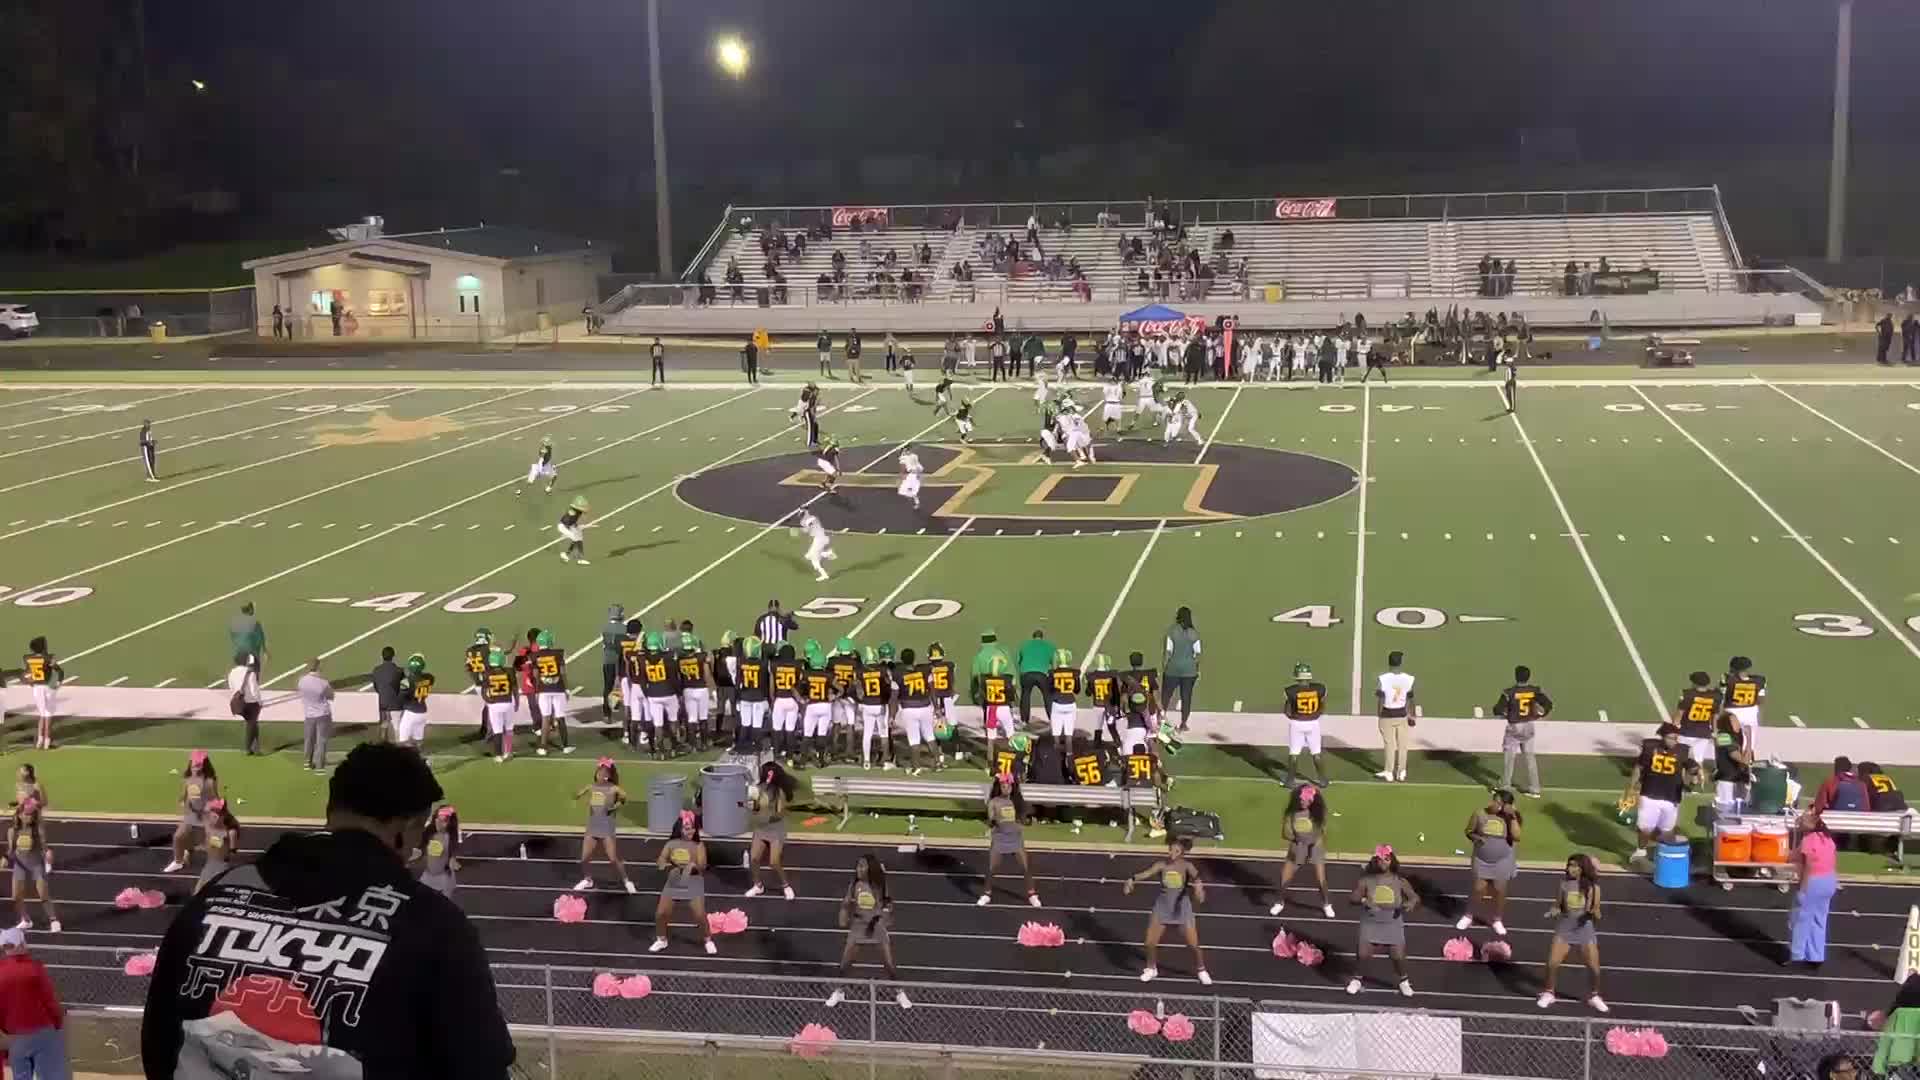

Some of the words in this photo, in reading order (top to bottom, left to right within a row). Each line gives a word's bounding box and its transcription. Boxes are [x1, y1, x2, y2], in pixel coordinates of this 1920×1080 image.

[743, 671, 758, 689] 14
[776, 673, 796, 690] 20
[866, 678, 881, 696] 13
[1055, 677, 1075, 693] 43
[810, 682, 825, 700] 21
[1297, 696, 1318, 714] 50
[1130, 760, 1150, 778] 34
[1651, 754, 1676, 775] 65
[1076, 766, 1101, 785] 56
[196, 913, 388, 983] TOKYO
